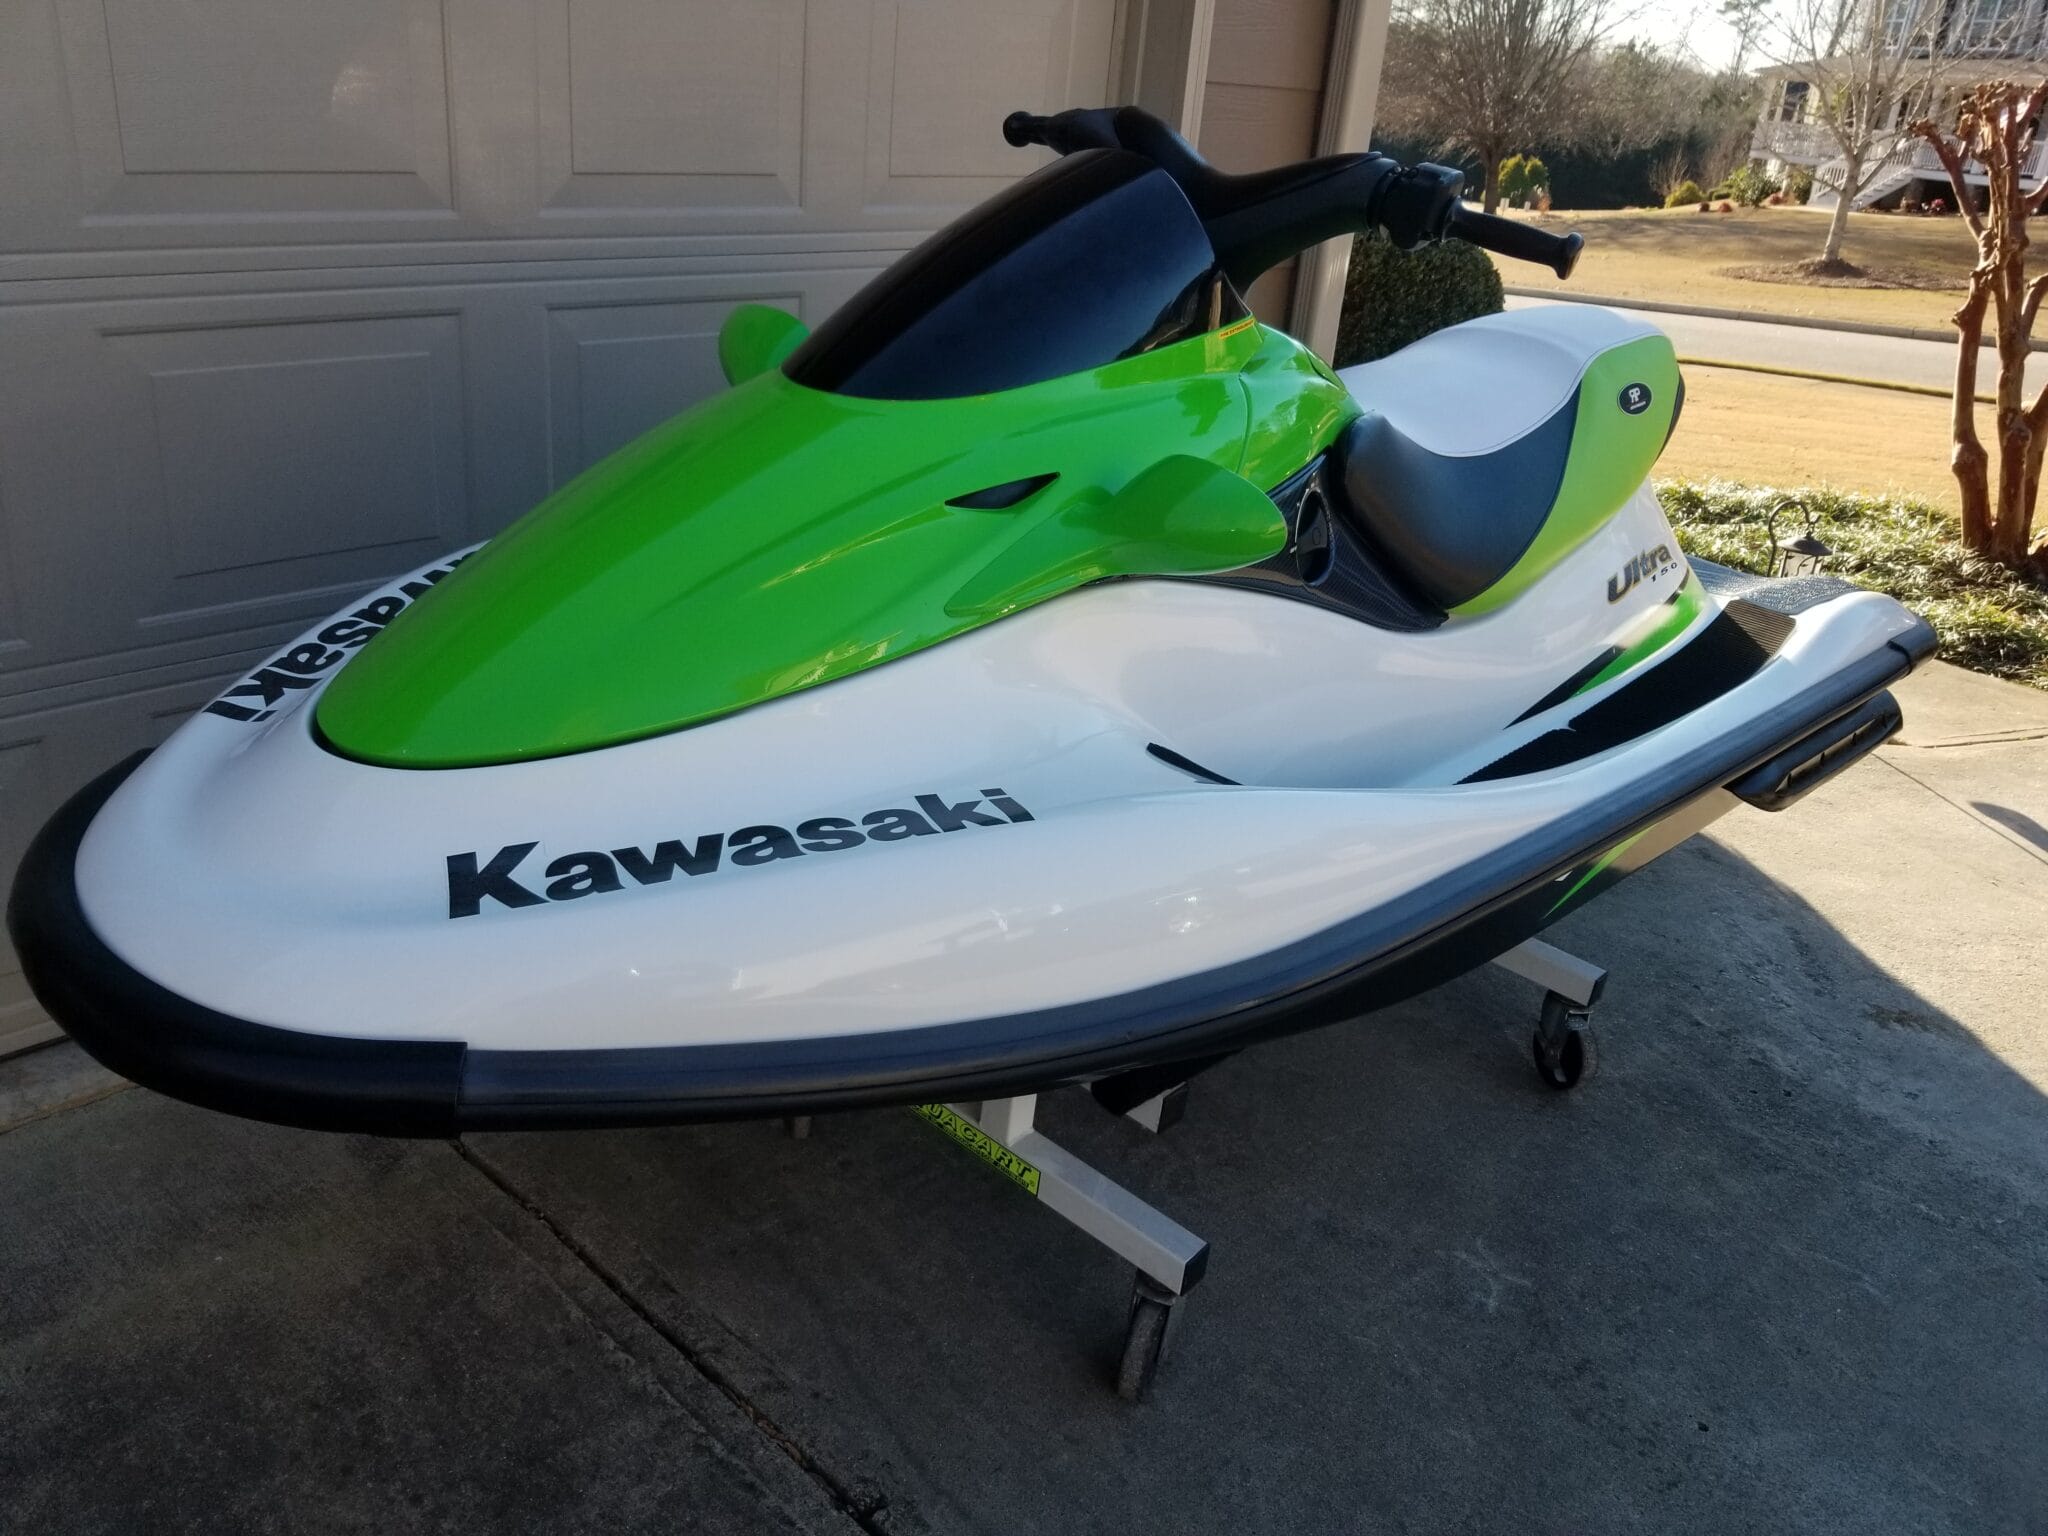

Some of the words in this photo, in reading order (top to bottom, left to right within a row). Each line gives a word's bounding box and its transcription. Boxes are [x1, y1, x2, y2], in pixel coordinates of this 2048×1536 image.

[1607, 543, 1673, 604] Ultra
[1650, 562, 1678, 583] 150
[446, 787, 1035, 919] Kawasaki
